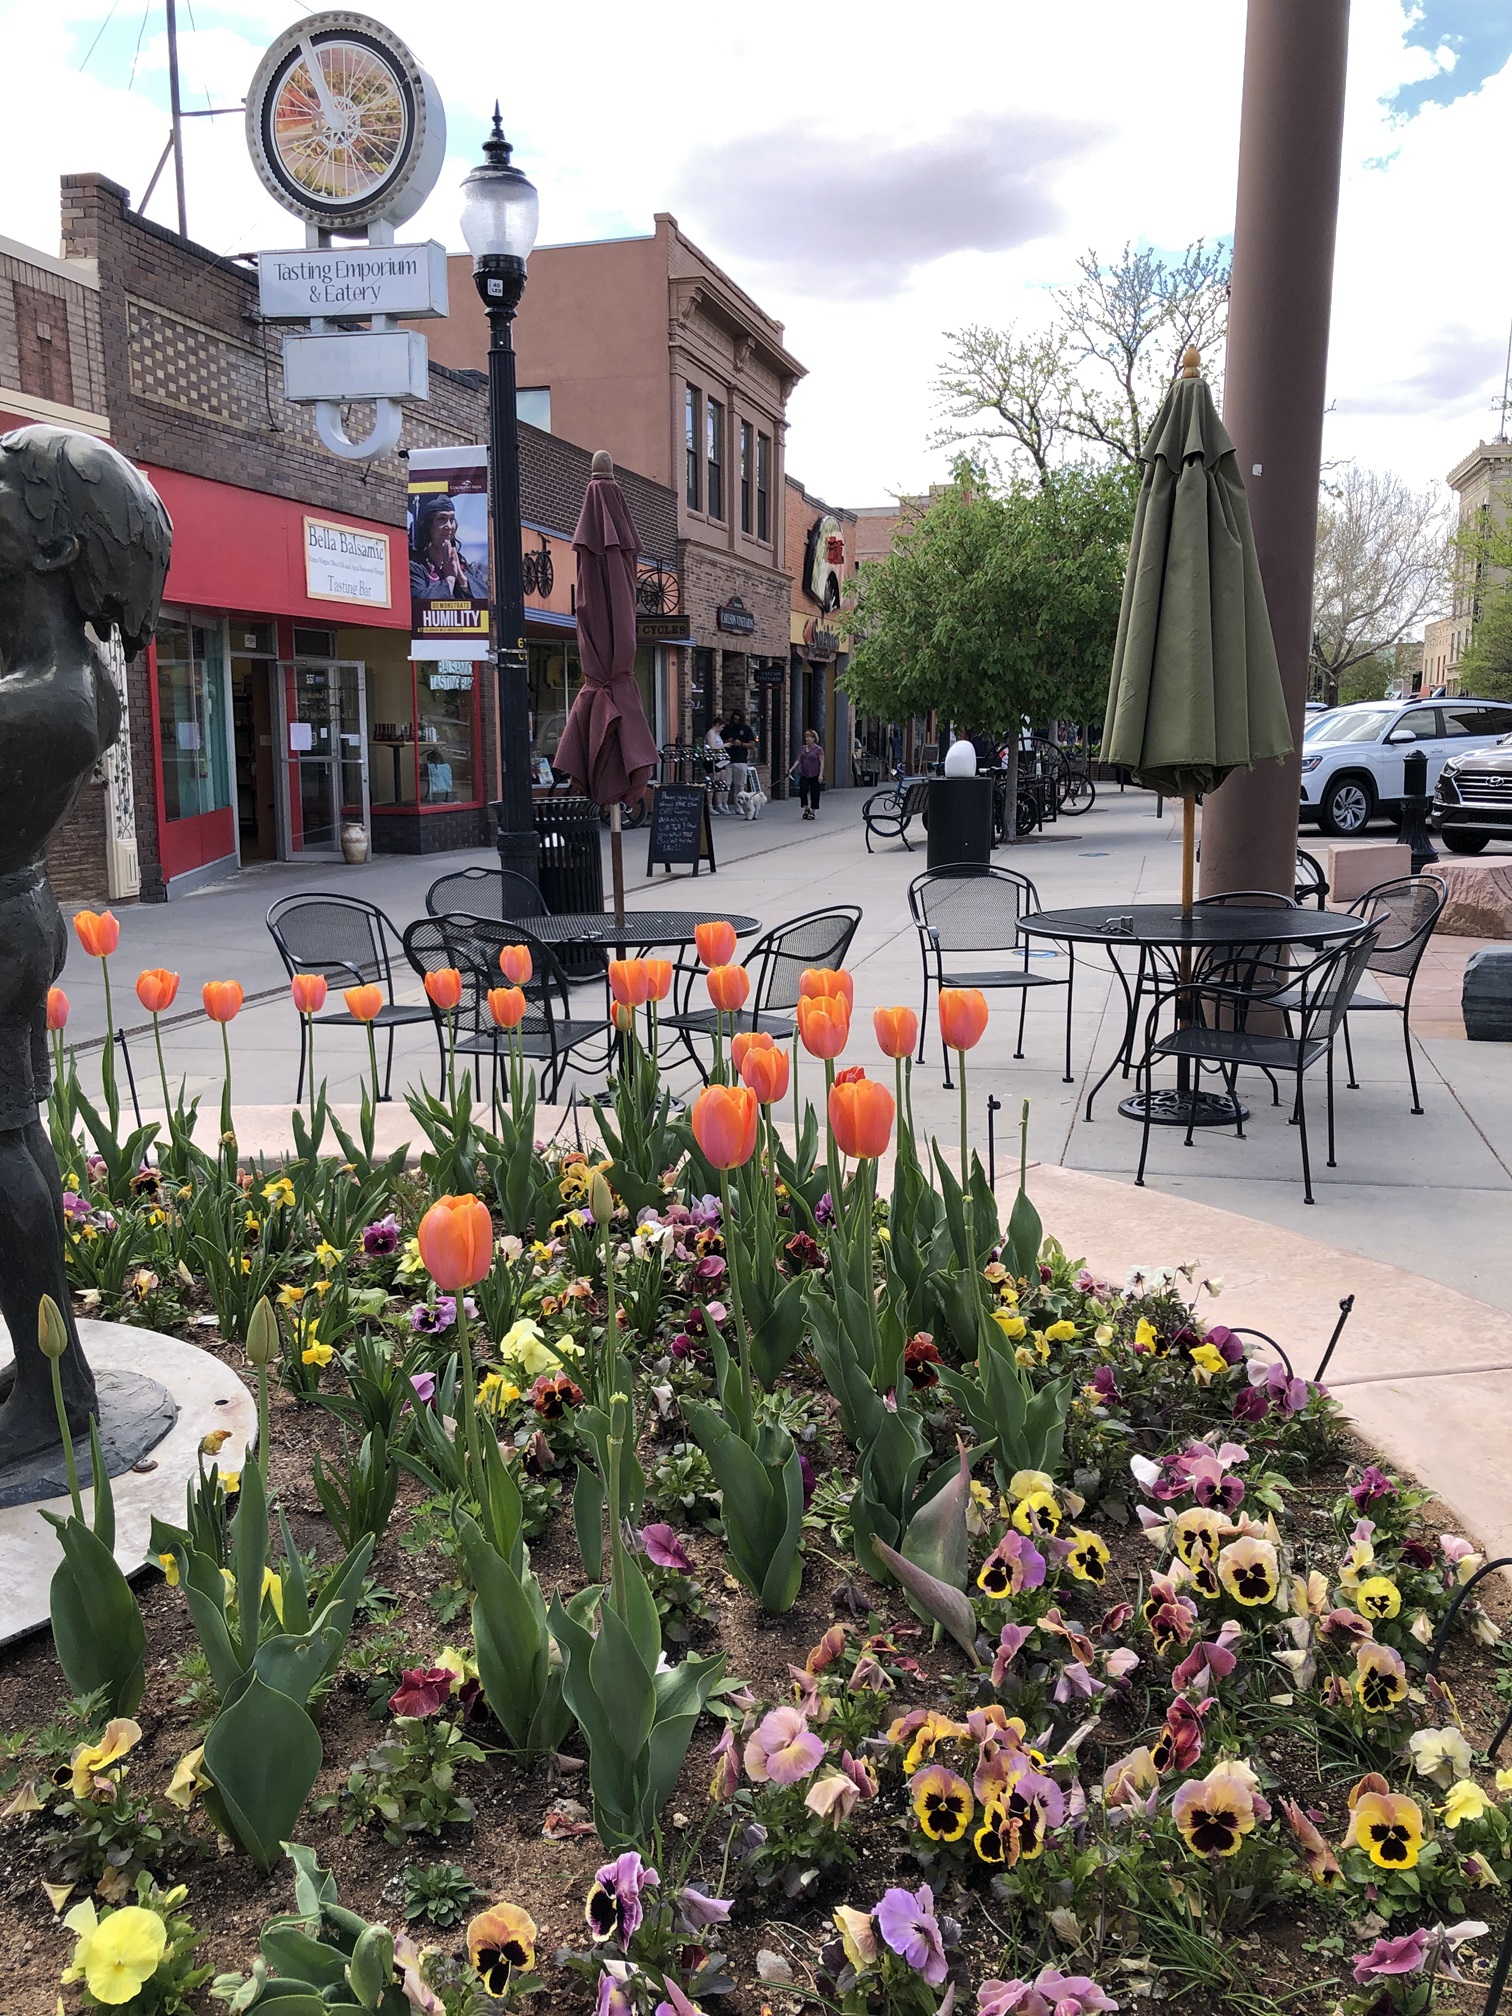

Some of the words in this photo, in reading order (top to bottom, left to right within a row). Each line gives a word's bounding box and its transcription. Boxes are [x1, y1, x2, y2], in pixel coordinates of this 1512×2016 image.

[273, 262, 333, 283] Tasting
[336, 258, 417, 282] Emporium
[309, 285, 321, 303] &
[325, 284, 381, 304] Eatery
[308, 525, 337, 552] Bella
[339, 532, 384, 561] Balsamic
[327, 574, 357, 598] Tasting
[359, 580, 372, 597] Bar
[422, 610, 480, 627] HUMILITY
[643, 625, 686, 635] CYCLES
